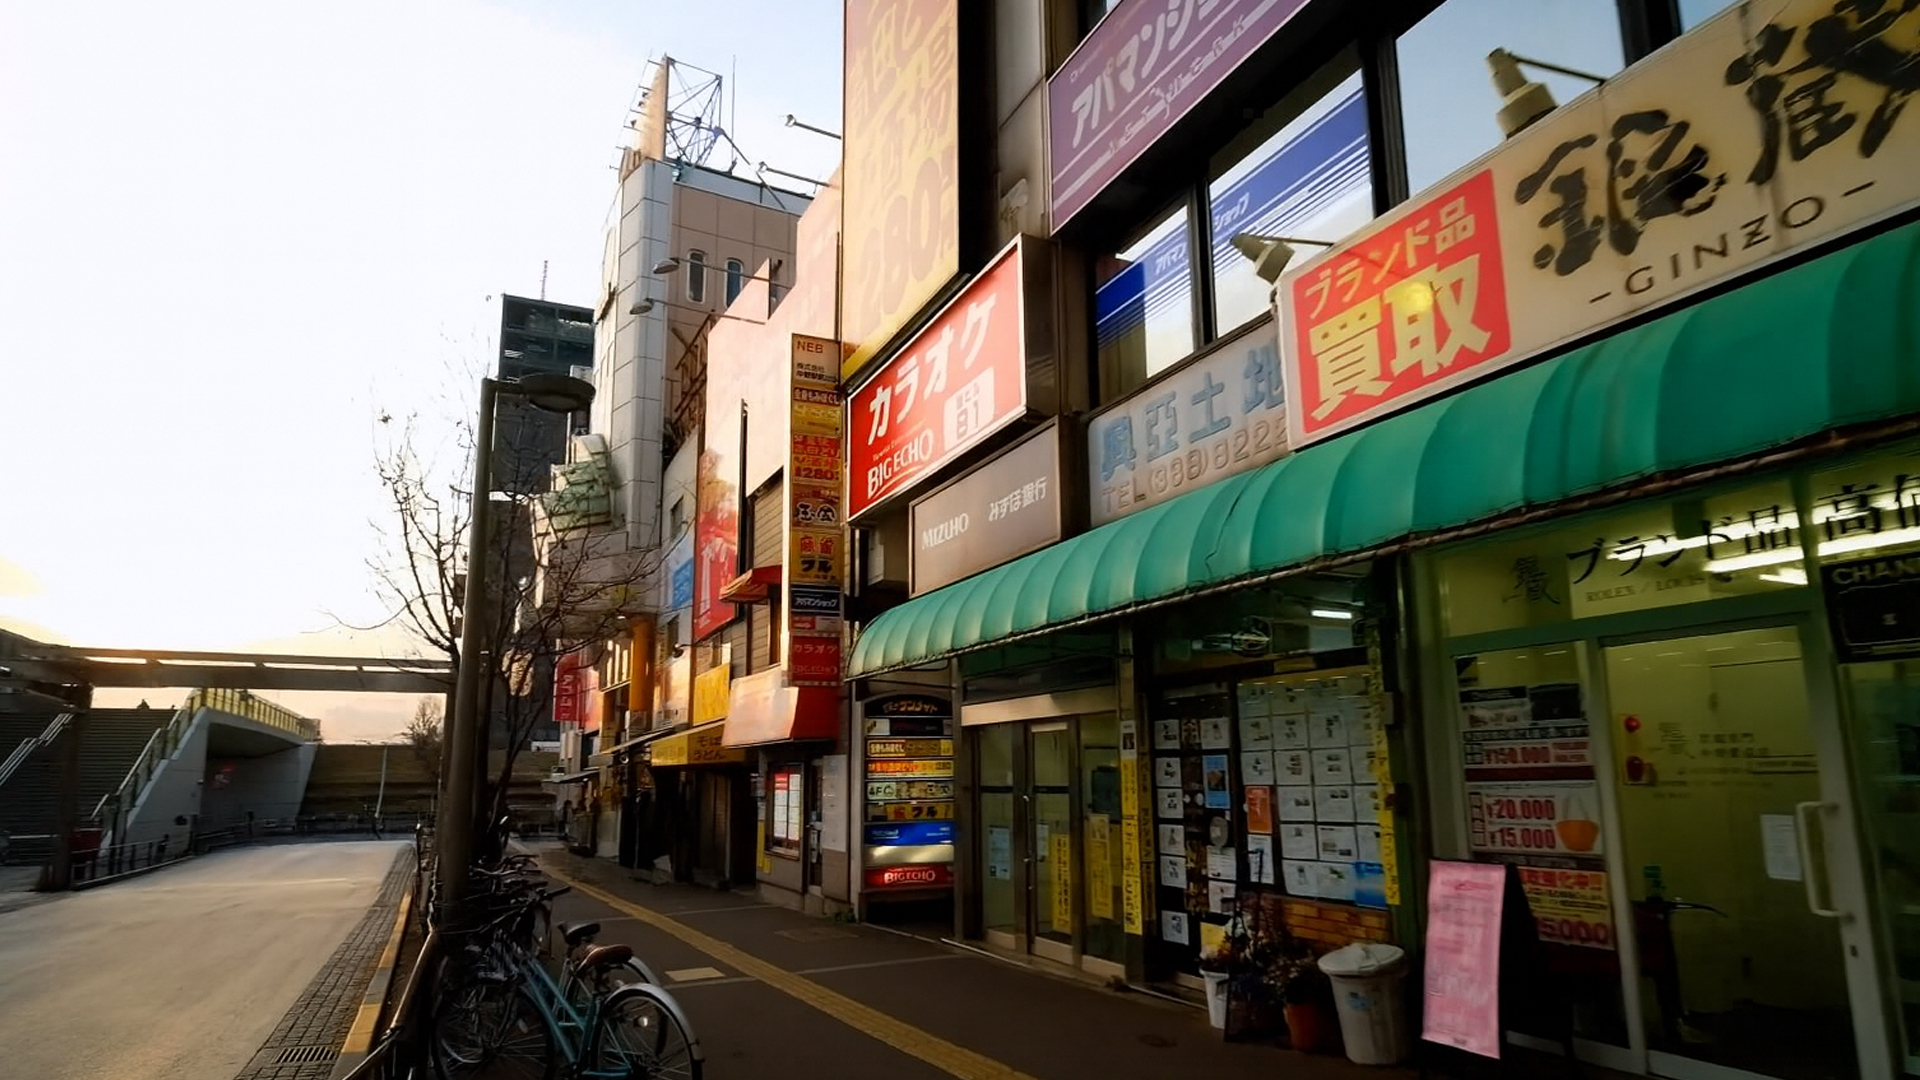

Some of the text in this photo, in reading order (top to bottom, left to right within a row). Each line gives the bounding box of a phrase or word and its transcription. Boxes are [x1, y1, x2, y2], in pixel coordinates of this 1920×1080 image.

[1304, 195, 1475, 318] ブランド品
[1625, 196, 1827, 296] GINZO
[797, 341, 824, 353] NEB
[867, 293, 997, 446] カラオケ
[1310, 253, 1491, 421] 買取
[867, 456, 893, 499] BIG
[893, 428, 934, 482] ECHO
[1101, 476, 1147, 513] TEL
[922, 476, 1048, 550] MIZUHO みずほ銀行
[1566, 504, 1794, 585] ブランド品
[793, 643, 838, 655] カラオケ
[884, 868, 936, 885] BIG ECHO
